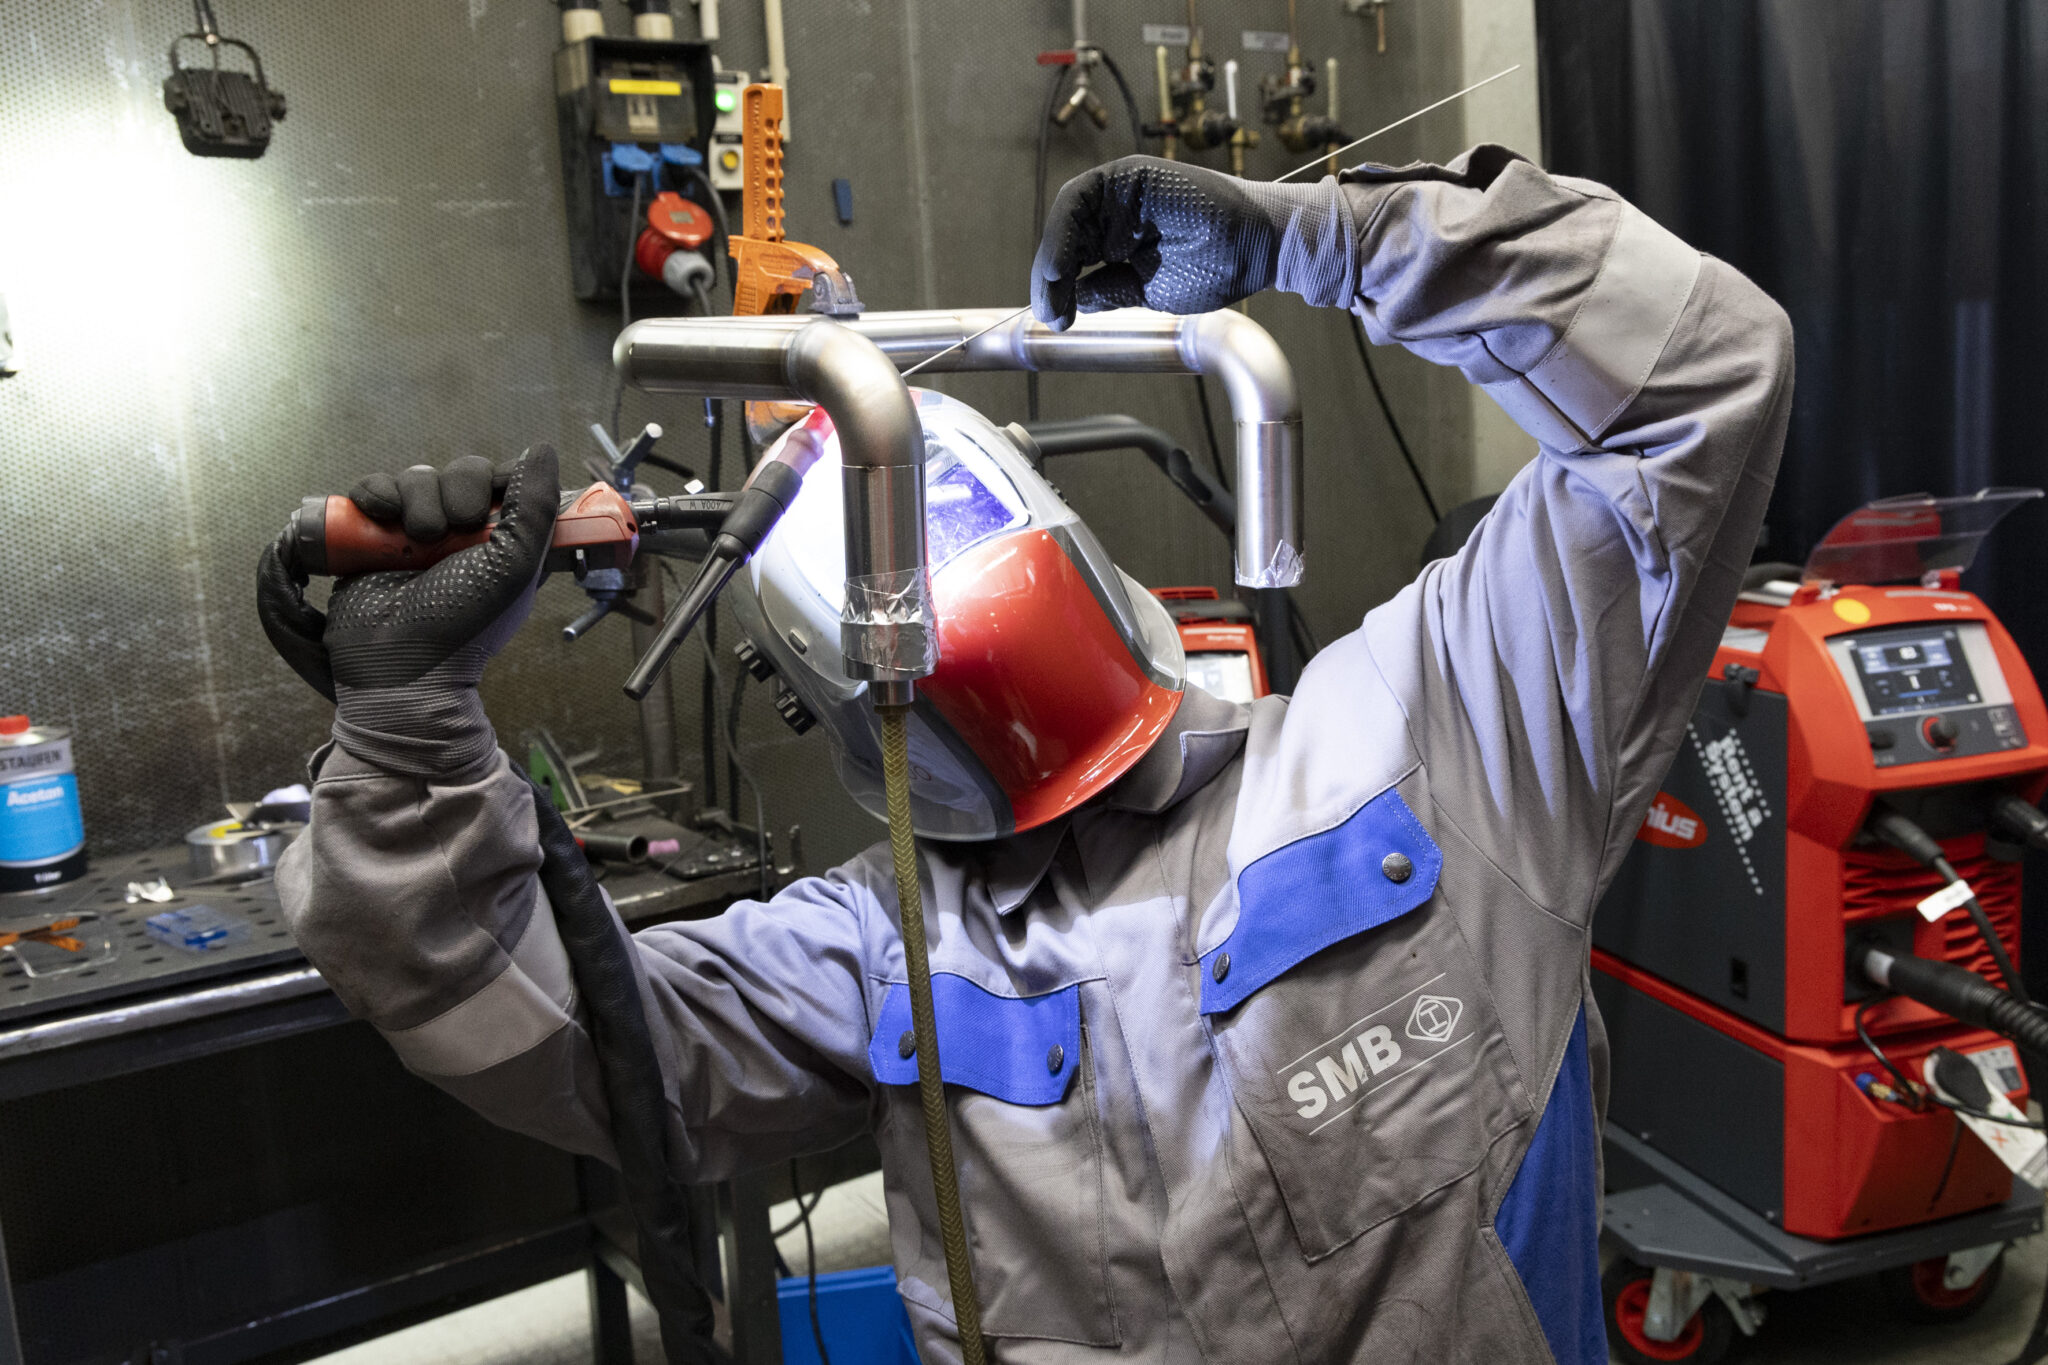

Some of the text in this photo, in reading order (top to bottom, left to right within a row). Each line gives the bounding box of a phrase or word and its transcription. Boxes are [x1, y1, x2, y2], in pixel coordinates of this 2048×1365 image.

[689, 500, 721, 510] 400A W
[6, 786, 65, 807] Aceton
[1705, 740, 1754, 842] System
[1719, 735, 1754, 805] Rent
[1288, 1025, 1402, 1119] SMB
